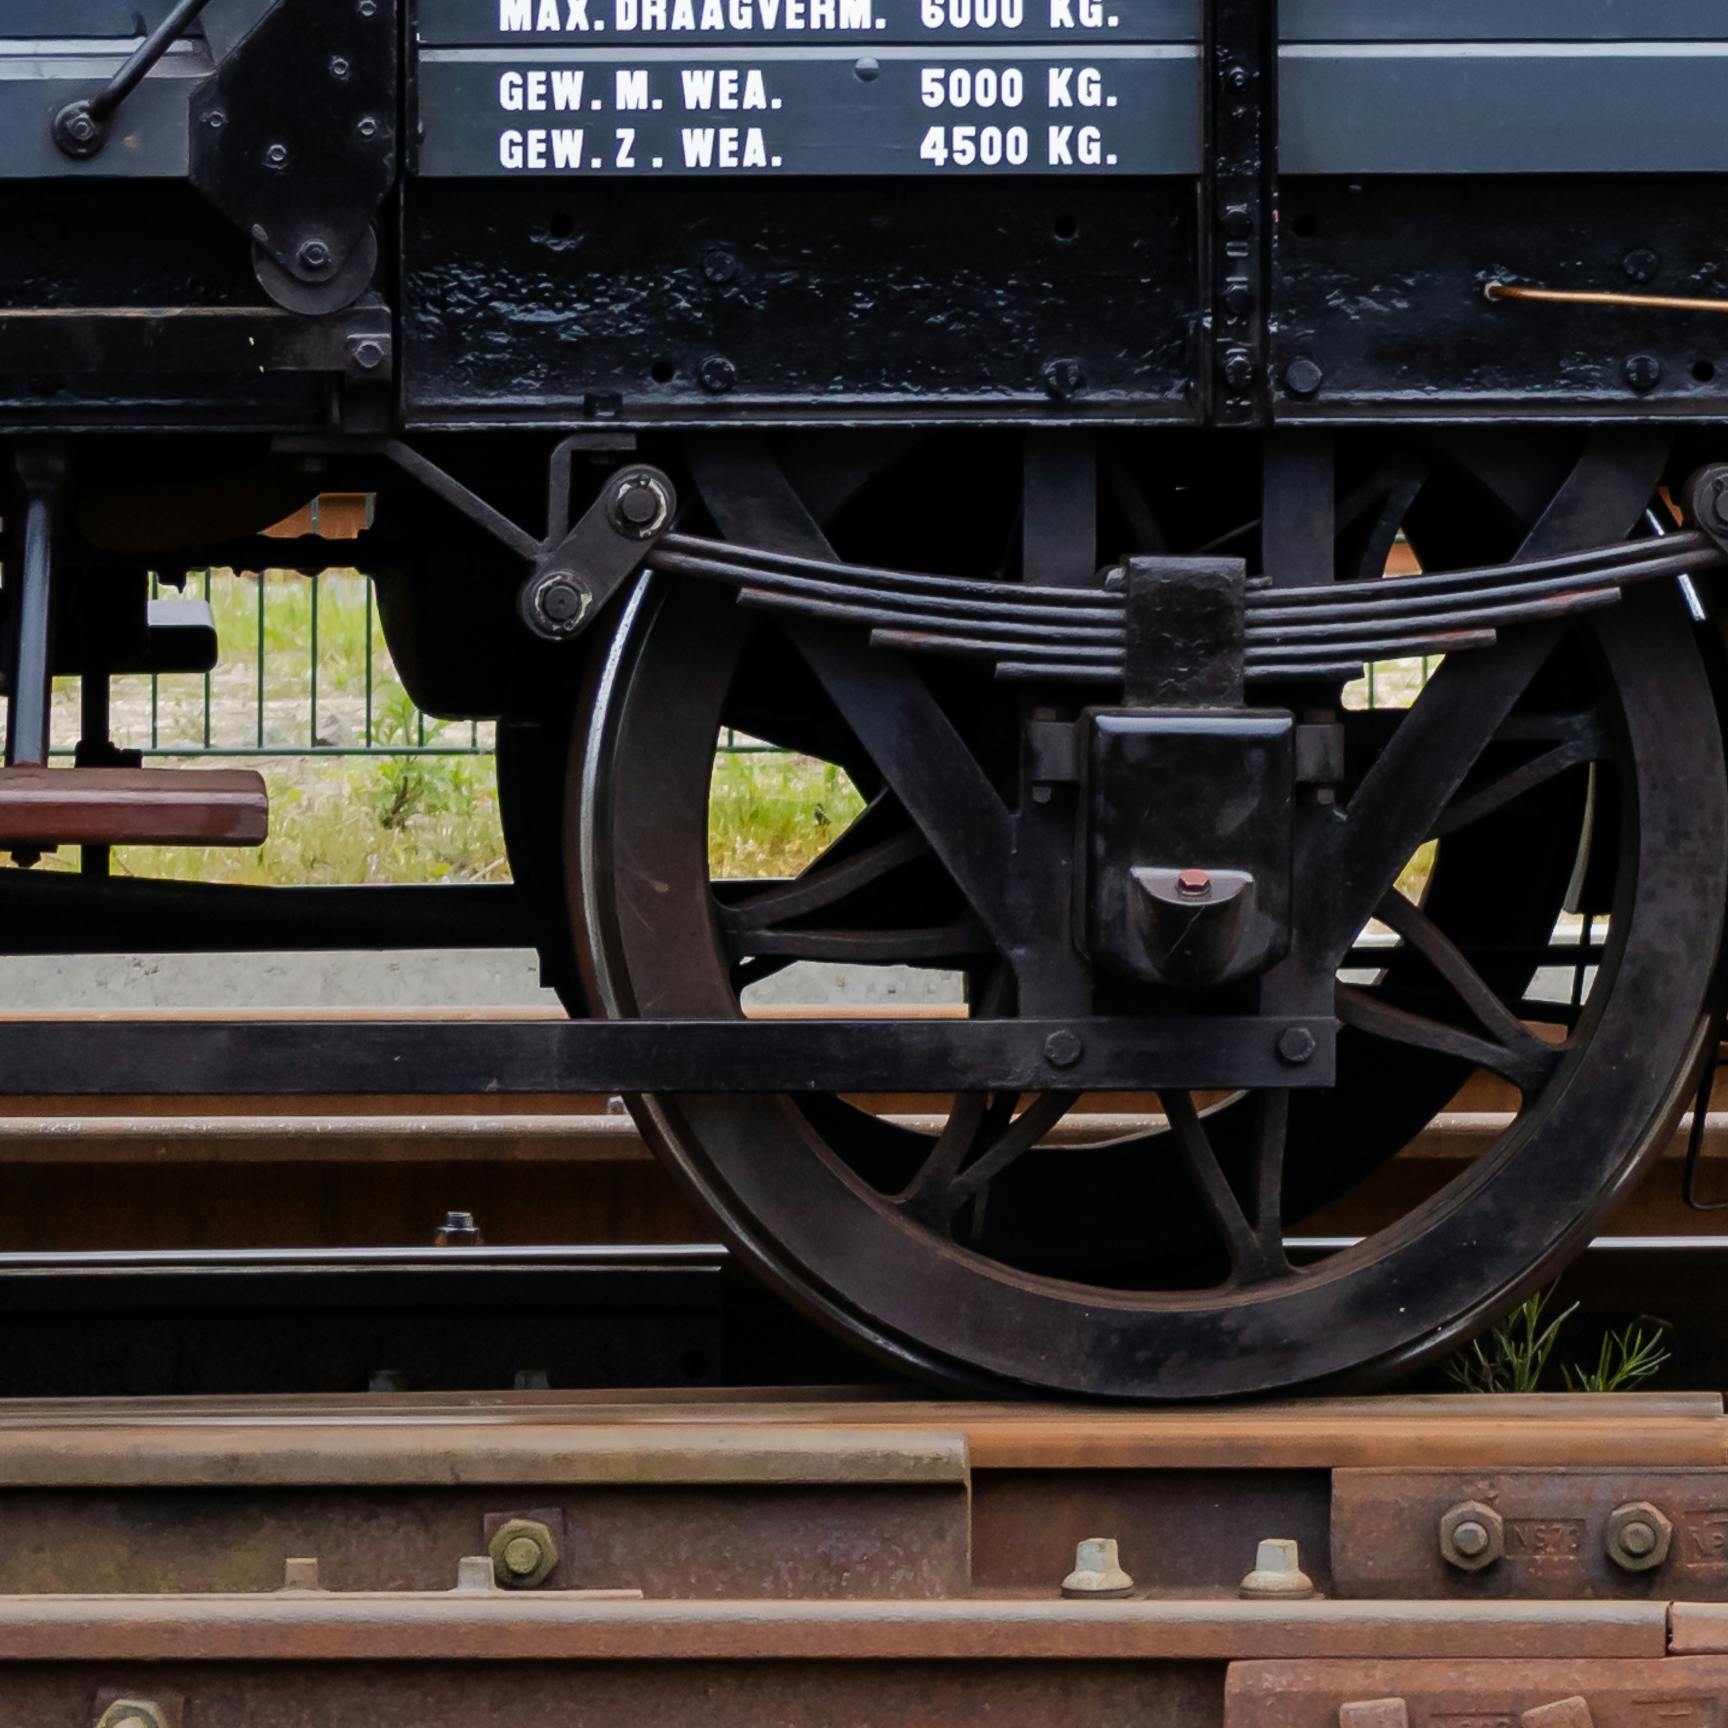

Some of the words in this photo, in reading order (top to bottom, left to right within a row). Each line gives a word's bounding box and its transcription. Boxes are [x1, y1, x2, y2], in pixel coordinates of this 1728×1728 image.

[499, 70, 602, 111] GEW.
[616, 70, 663, 110] M.
[681, 69, 782, 110] WEA.
[921, 68, 1023, 108] 5000
[1048, 67, 1117, 107] KG.
[499, 129, 602, 169] GEW.
[681, 127, 782, 168] WEA.
[920, 126, 1028, 166] 4500
[1048, 125, 1117, 165] KG.
